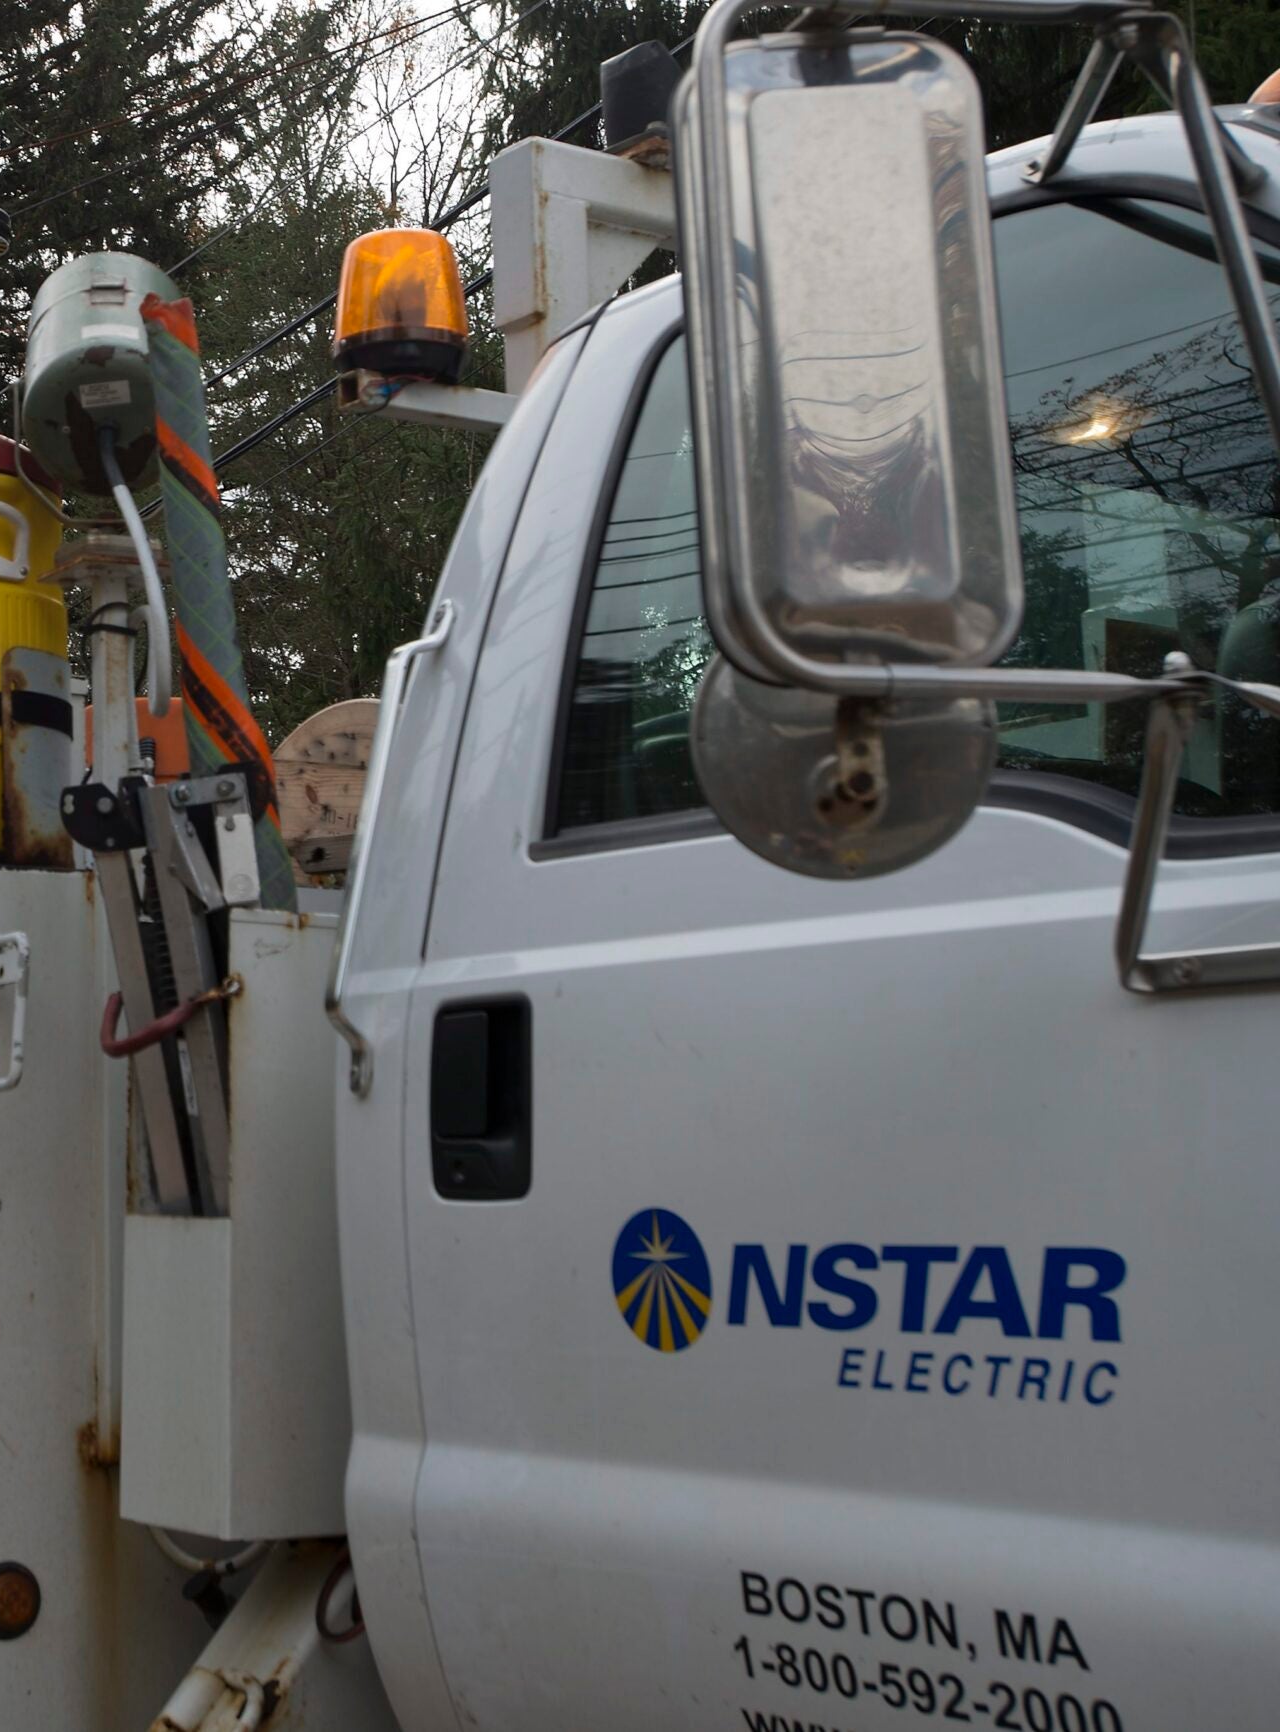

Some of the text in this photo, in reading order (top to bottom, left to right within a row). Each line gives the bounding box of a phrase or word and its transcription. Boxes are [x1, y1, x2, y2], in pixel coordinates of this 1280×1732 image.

[727, 1243, 1128, 1343] NSTAR
[837, 1348, 1120, 1406] ELECTRIC
[740, 1571, 1091, 1672] BOSTON, MA
[732, 1635, 1125, 1732] 1-800-592-2000
